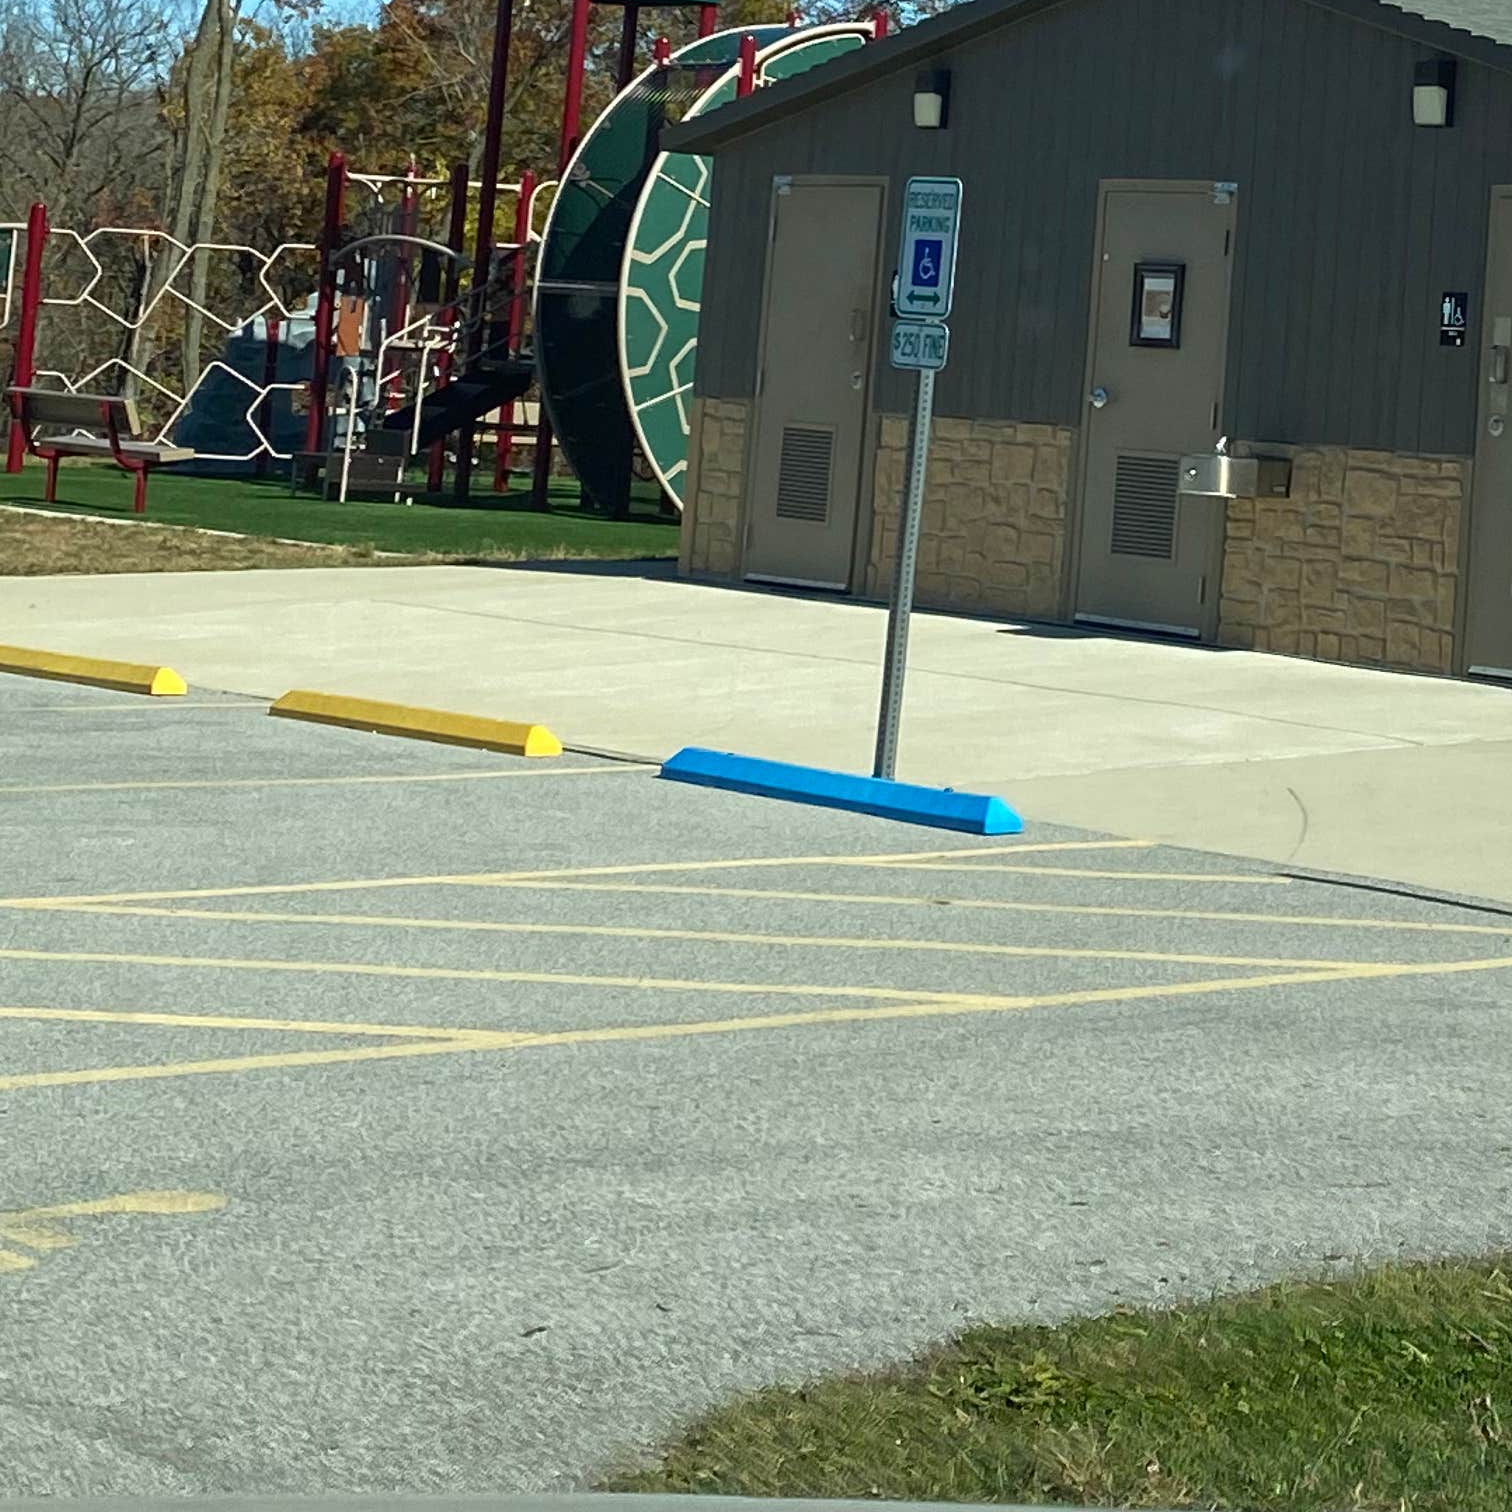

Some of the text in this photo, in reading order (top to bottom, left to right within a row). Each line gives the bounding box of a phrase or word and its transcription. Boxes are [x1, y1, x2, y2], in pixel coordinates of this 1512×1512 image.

[910, 192, 954, 209] RESERVED
[910, 215, 950, 233] PARKING
[923, 335, 945, 359] FINE
